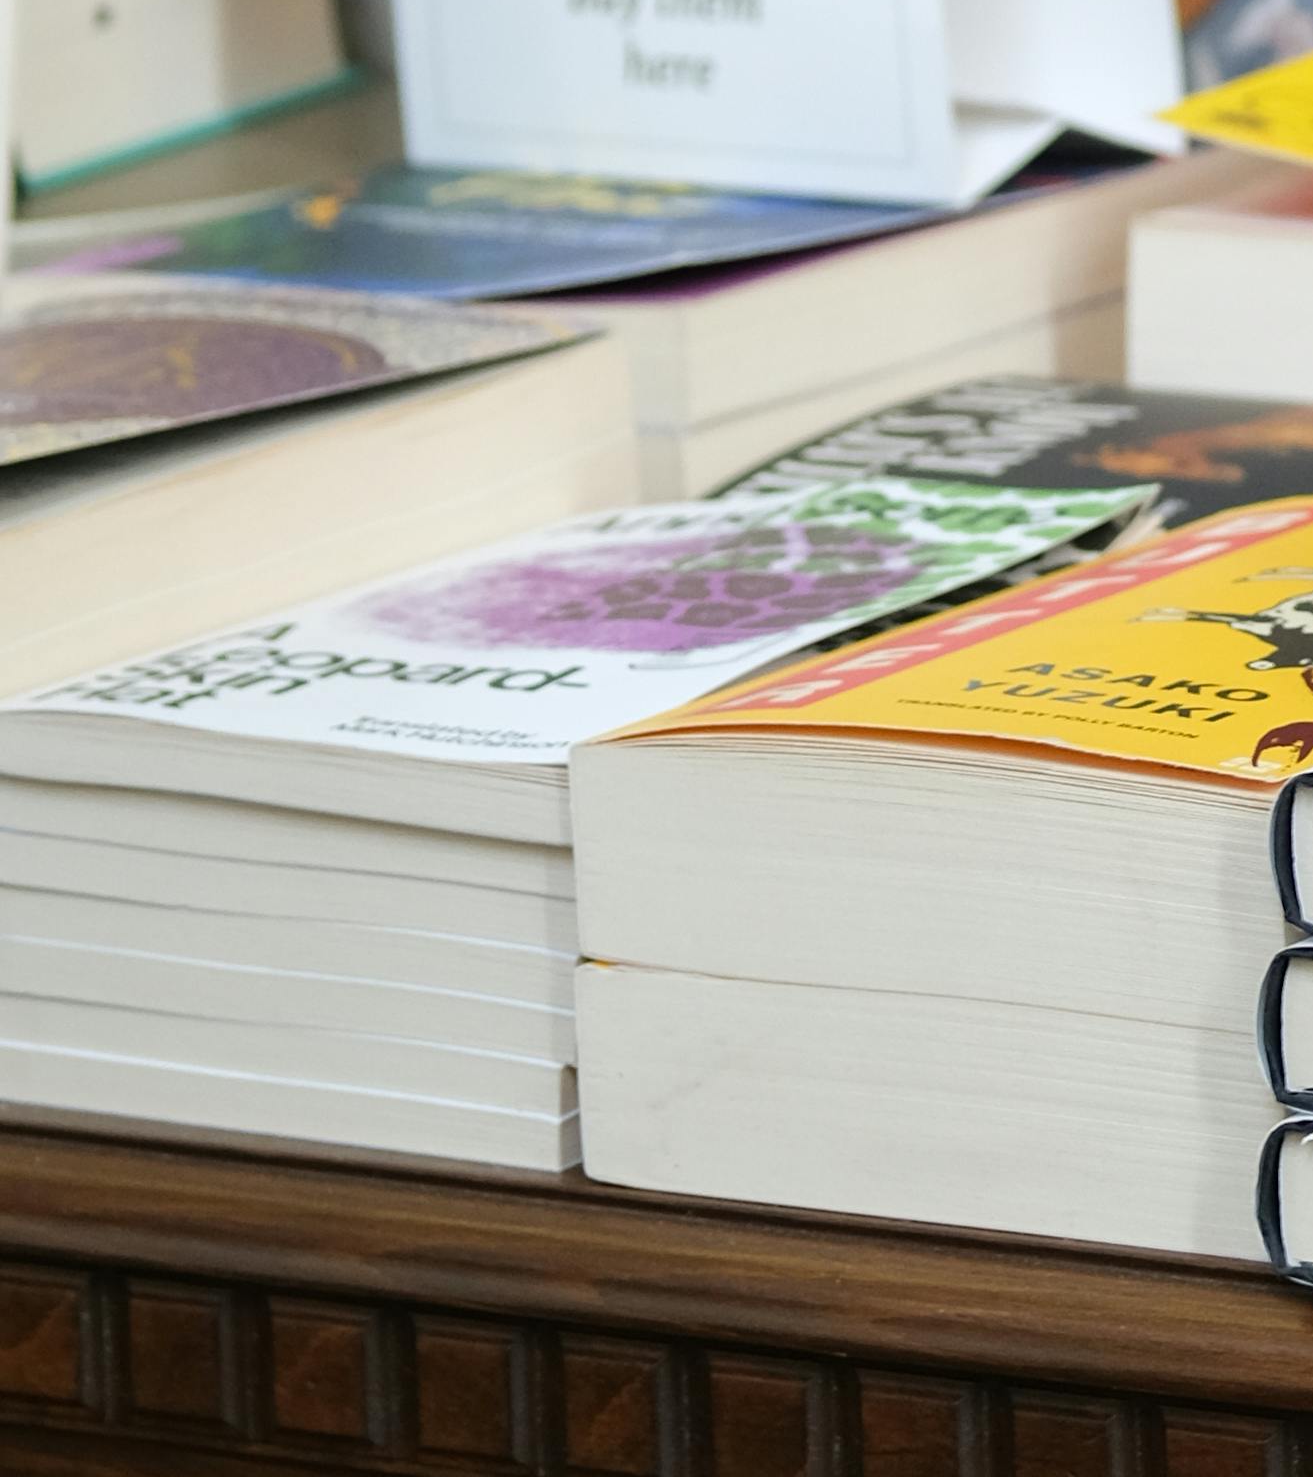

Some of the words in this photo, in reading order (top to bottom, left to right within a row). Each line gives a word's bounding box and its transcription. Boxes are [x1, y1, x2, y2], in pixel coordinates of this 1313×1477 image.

[622, 42, 715, 92] here
[156, 643, 590, 692] Leopard-
[1006, 662, 1270, 702] ASAKO
[32, 678, 218, 708] Hat
[963, 679, 1236, 722] YUZUKI
[897, 698, 1020, 714] TRANSLATED
[1051, 713, 1115, 727] POLLY
[1116, 722, 1201, 740] BARTON
